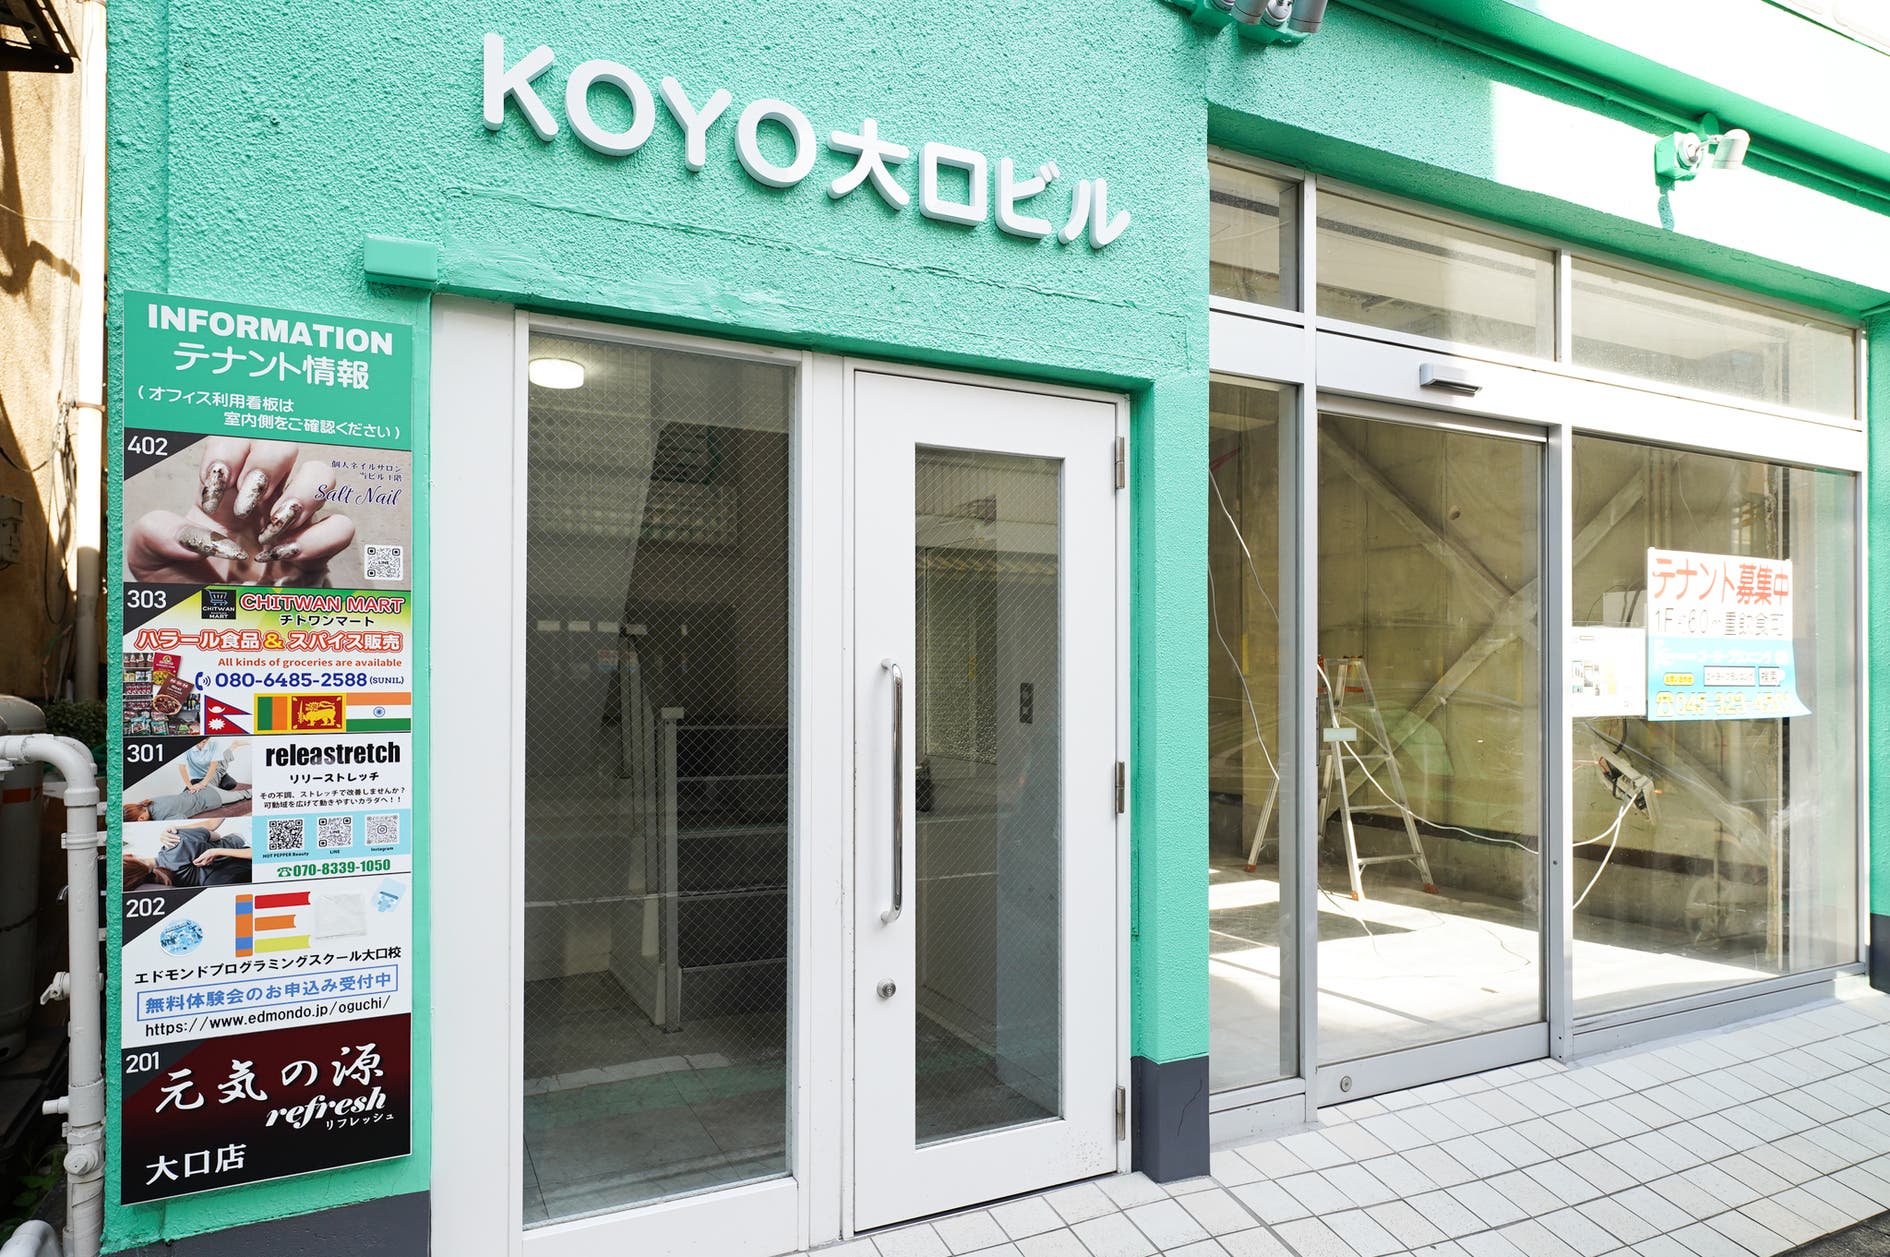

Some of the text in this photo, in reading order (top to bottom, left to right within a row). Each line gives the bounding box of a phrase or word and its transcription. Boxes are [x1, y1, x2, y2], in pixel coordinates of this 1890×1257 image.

[483, 32, 1131, 250] KOYO大口ビル
[148, 303, 393, 355] INFORMATION
[173, 342, 370, 390] テナント情報
[223, 412, 401, 440] 室内側をご確認ください）
[127, 436, 168, 456] 402
[331, 460, 401, 473] 個人ネイルサロン
[314, 484, 402, 505] Salt Nail
[1652, 558, 1789, 606] テナント募集中
[126, 590, 167, 609] 303
[241, 594, 404, 613] CHITWAN MART
[280, 615, 375, 627] チトワンマート
[137, 629, 403, 651] ハラール食品 & スパイス販売
[218, 658, 402, 669] All kinds of groceries are available
[215, 673, 404, 688] 080-6485-2588 (SUNIL)
[126, 743, 164, 763] 301
[265, 741, 401, 767] releastretch
[290, 771, 380, 784] リリーストレッチ
[293, 859, 391, 877] 070-8339-1050
[126, 897, 166, 919] 202
[134, 946, 401, 984] エドモンドプログラミングスクール大口校
[145, 972, 392, 1014] 無料体験会のお申込み受付中
[145, 995, 391, 1038] https://www.edmondo.jp/oguchi/
[125, 1051, 160, 1074] 201
[155, 1042, 384, 1114] 元気の源
[265, 1086, 387, 1129] refresh
[326, 1113, 395, 1131] リフレッシュ
[146, 1143, 247, 1186] 大口店
